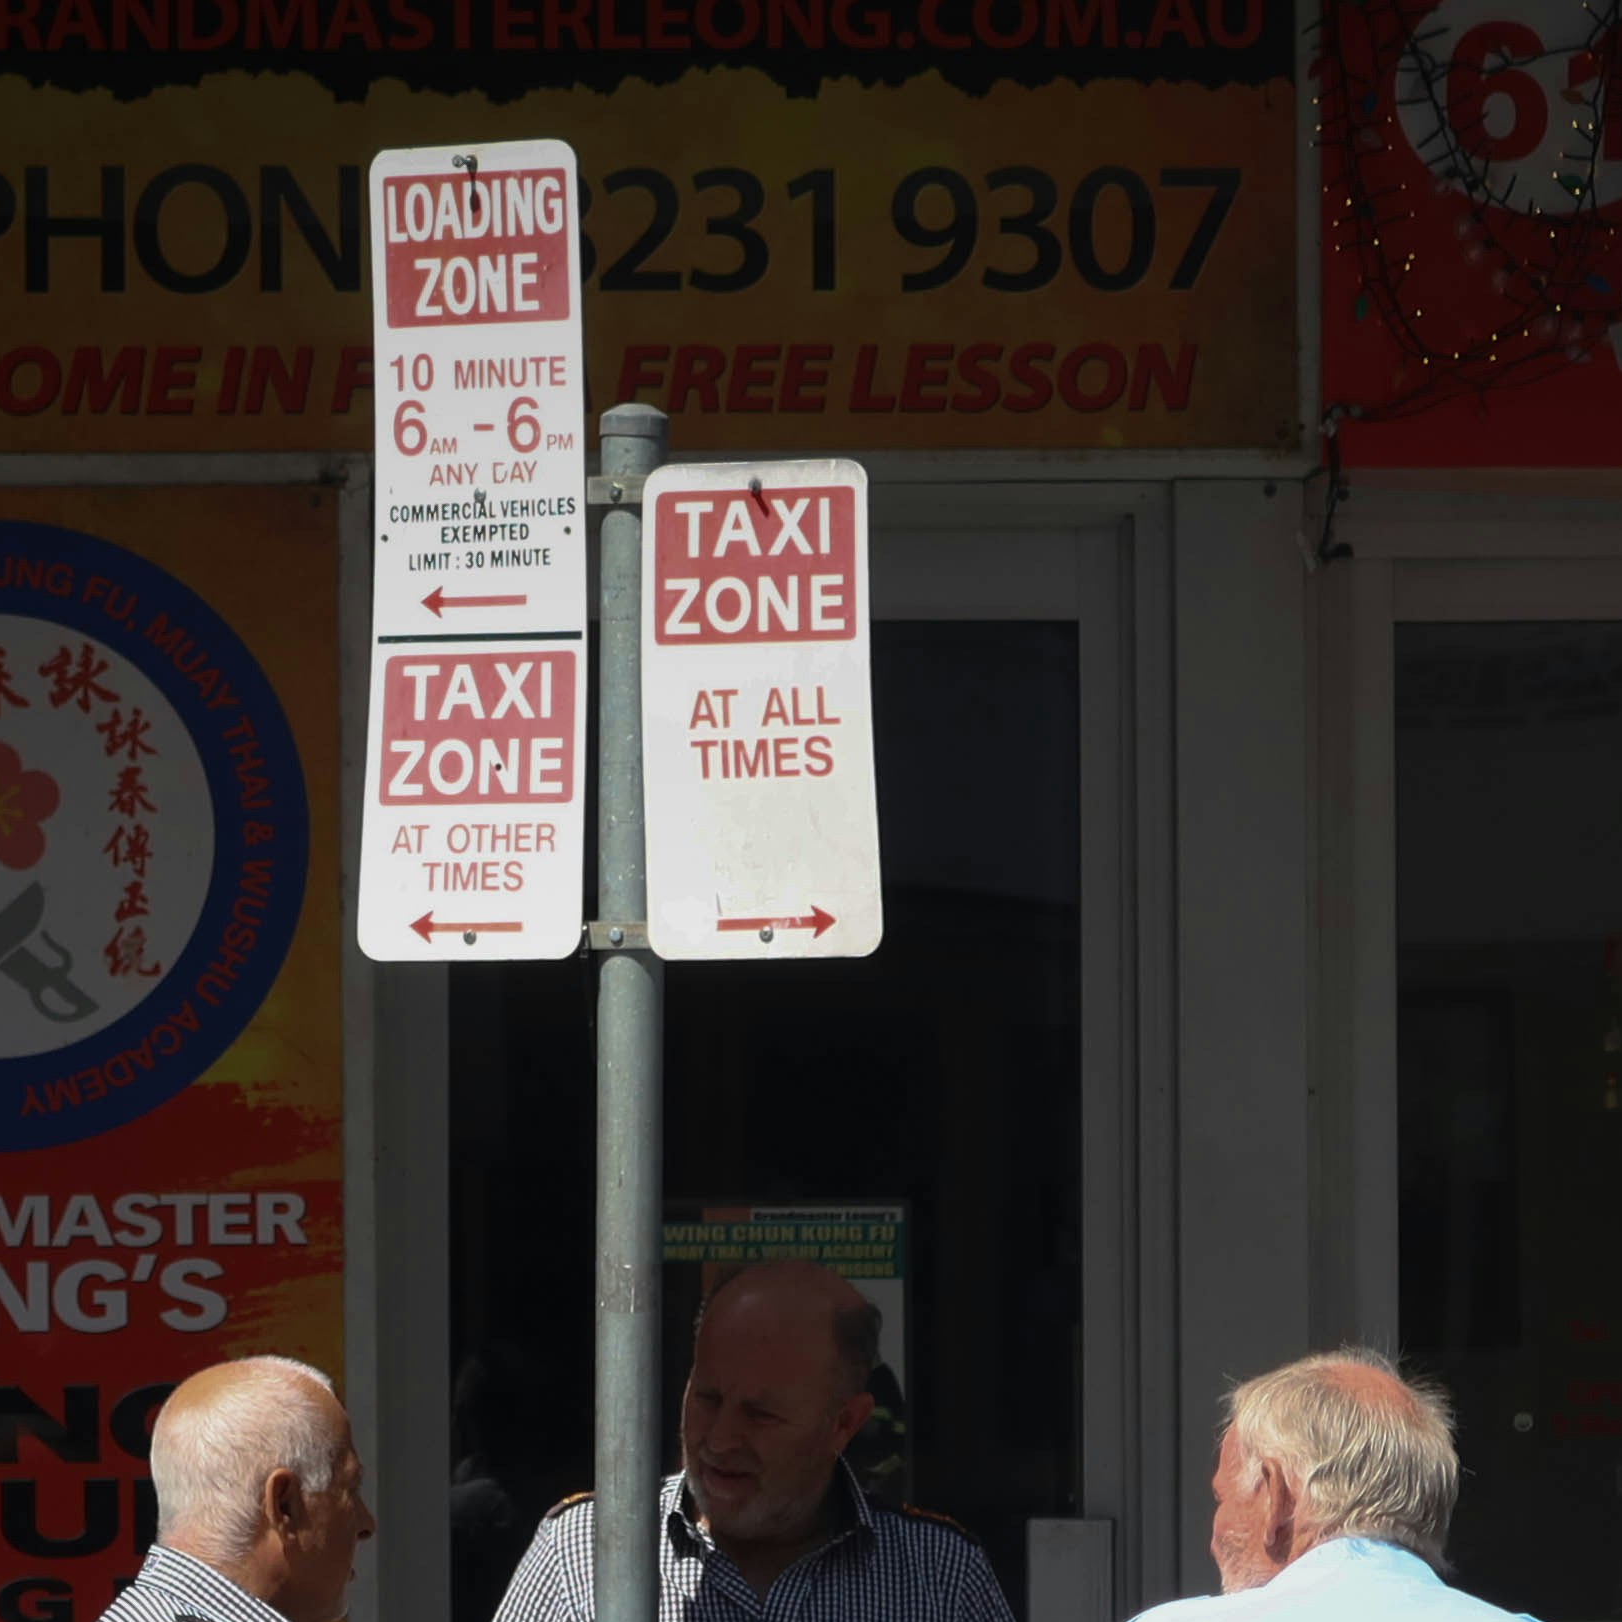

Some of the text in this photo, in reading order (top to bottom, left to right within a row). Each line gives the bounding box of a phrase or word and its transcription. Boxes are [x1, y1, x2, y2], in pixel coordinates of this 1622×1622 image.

[387, 176, 564, 244] LOADING
[582, 166, 836, 293] 231
[890, 166, 1243, 293] 9307
[414, 252, 540, 318] ZONE
[216, 345, 313, 414] IN
[389, 353, 434, 392] 10
[454, 355, 567, 391] MINUTE
[617, 341, 1198, 415] FREE LESSON
[429, 460, 537, 487] ANY DAY
[390, 496, 576, 524] COMMERCIAL VEHICLES
[440, 521, 530, 545] EXEMPTED
[673, 496, 832, 559] TAXI
[464, 550, 486, 570] 30
[490, 547, 552, 569] MINUTE
[80, 573, 142, 634] FU,
[663, 573, 847, 635] ZONE
[143, 610, 240, 713] MUAY
[401, 660, 553, 722] TAXI
[688, 685, 841, 729] AT ALL
[222, 715, 274, 813] THAI
[387, 737, 564, 797] ZONE
[690, 735, 834, 780] TIMES
[241, 820, 274, 847] &
[391, 823, 557, 855] AT OTHER
[422, 860, 525, 893] TIMES
[195, 857, 275, 1009] WUSHU
[19, 996, 203, 1119] ACADEMY
[663, 1224, 727, 1243] WING
[730, 1224, 795, 1243] CHUN
